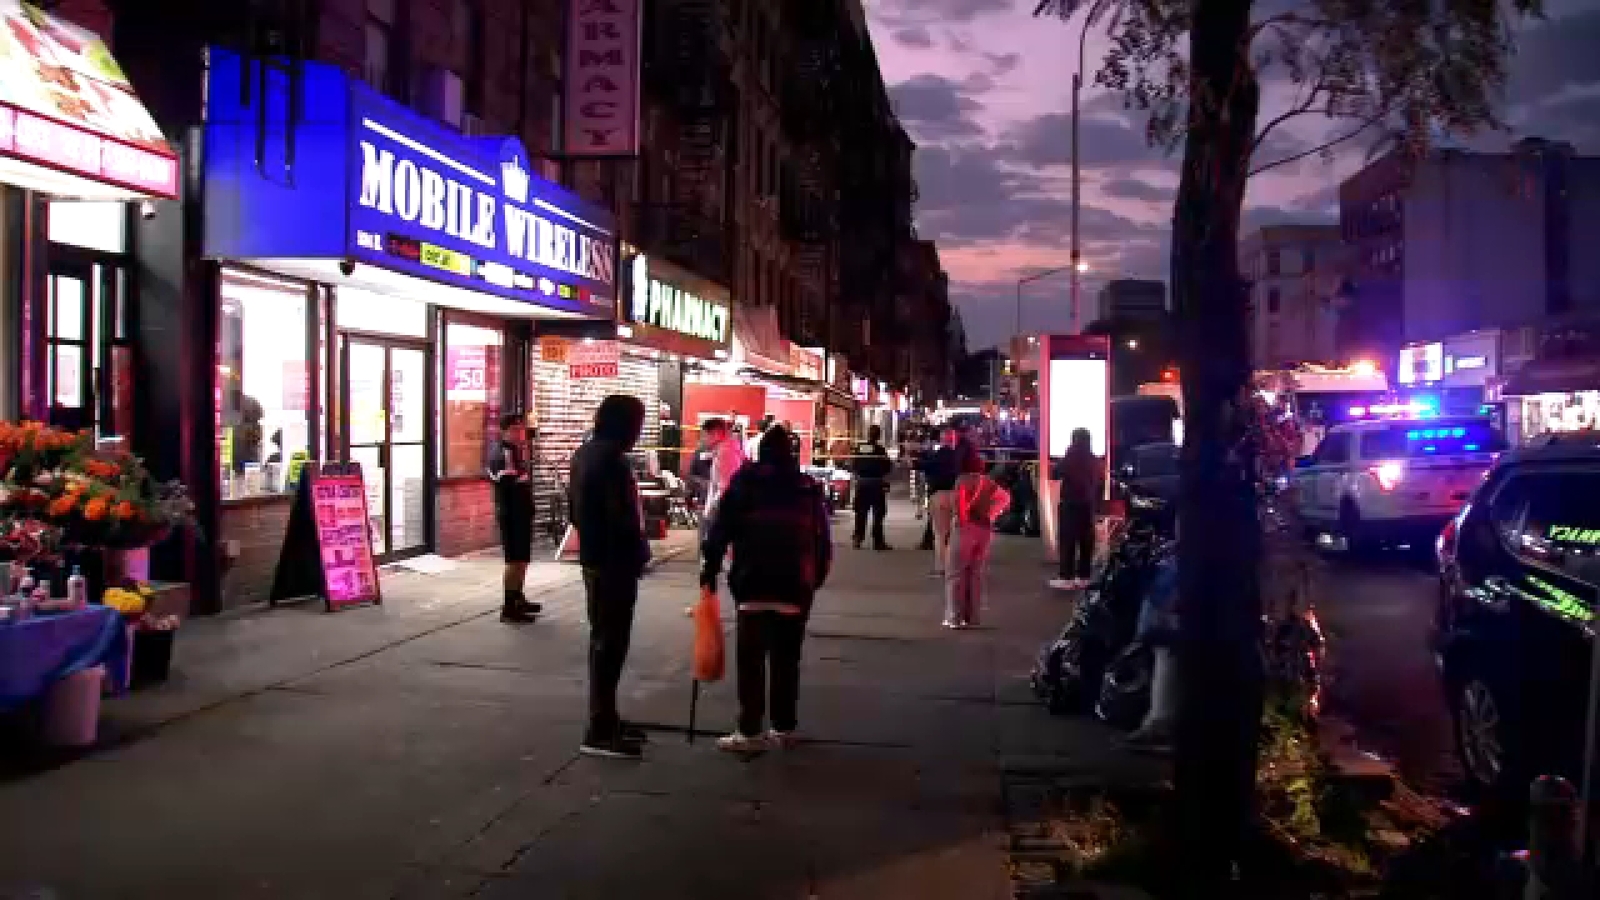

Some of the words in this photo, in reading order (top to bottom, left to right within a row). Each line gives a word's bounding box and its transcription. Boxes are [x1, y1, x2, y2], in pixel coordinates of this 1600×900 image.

[360, 139, 497, 249] MOBILE
[503, 202, 614, 285] WIRELESS
[649, 279, 728, 344] PHARMACY
